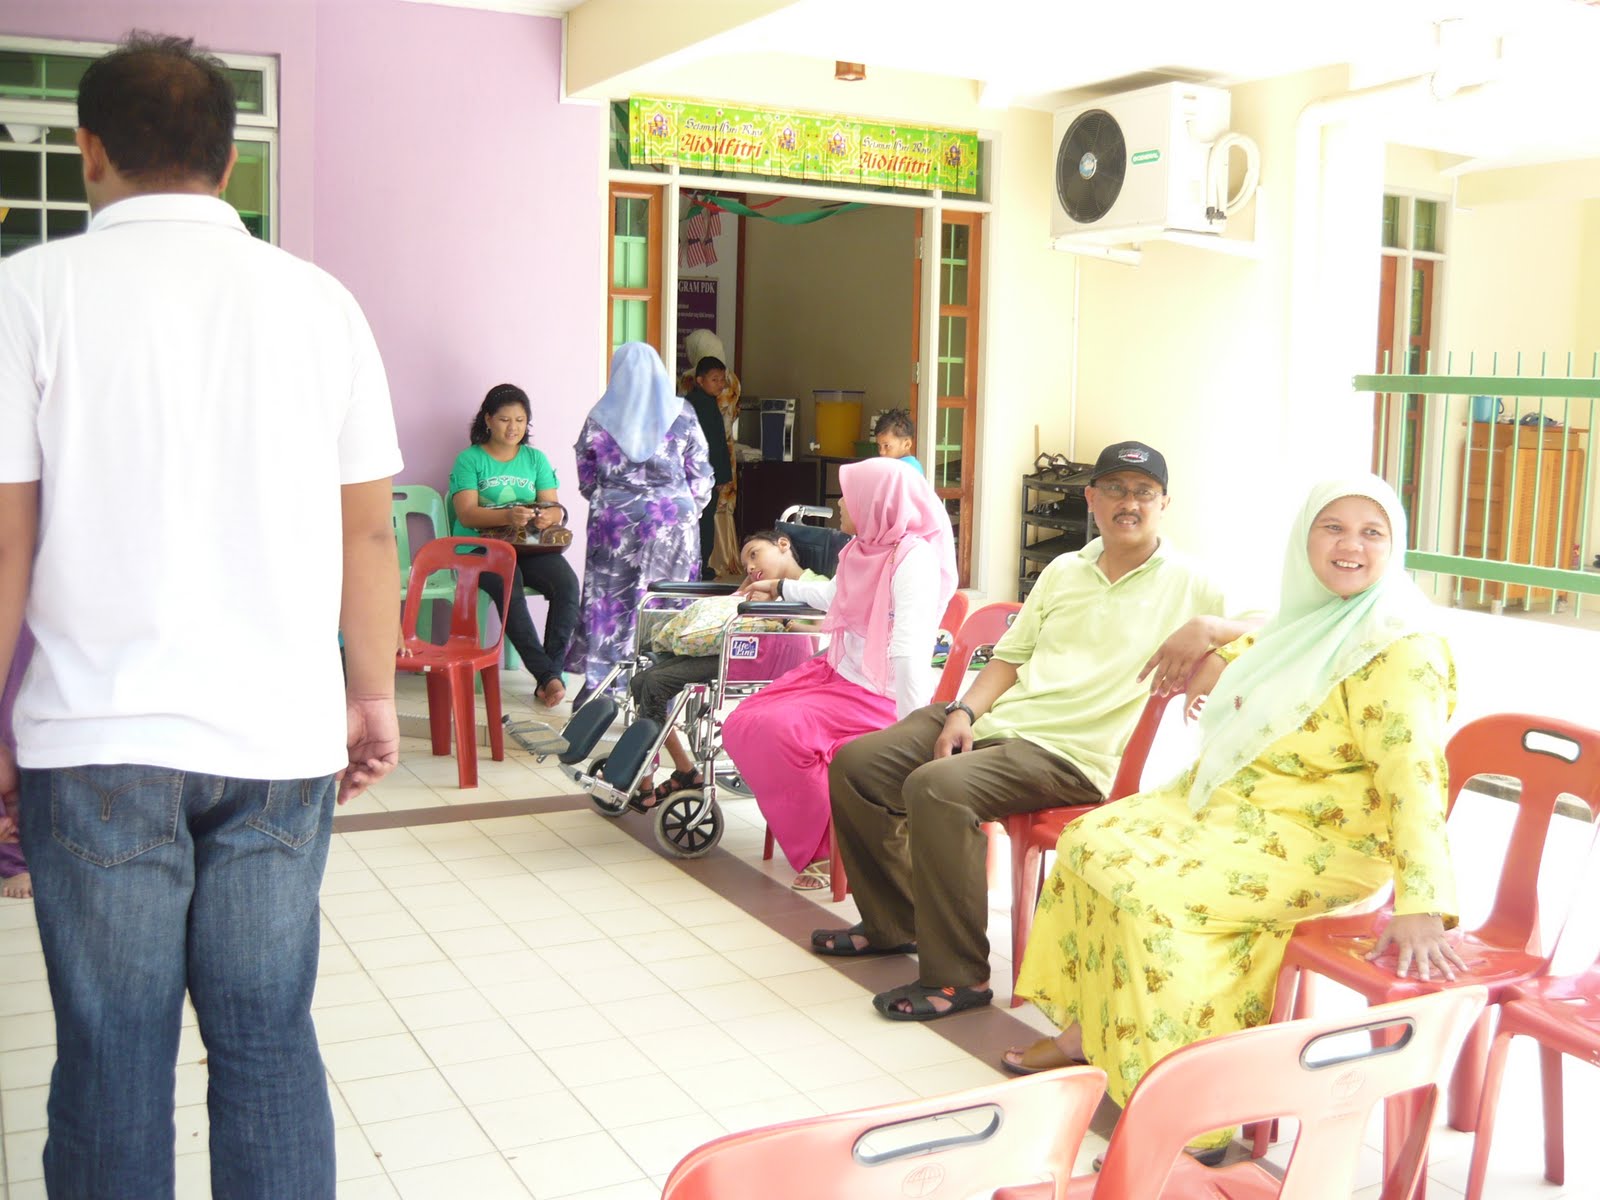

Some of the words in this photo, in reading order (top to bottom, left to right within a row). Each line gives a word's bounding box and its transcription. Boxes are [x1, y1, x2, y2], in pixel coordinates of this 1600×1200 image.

[680, 133, 762, 157] Aidilfitri
[859, 151, 931, 173] Aidilfitri
[679, 281, 700, 293] GRAM
[701, 282, 715, 293] PDK
